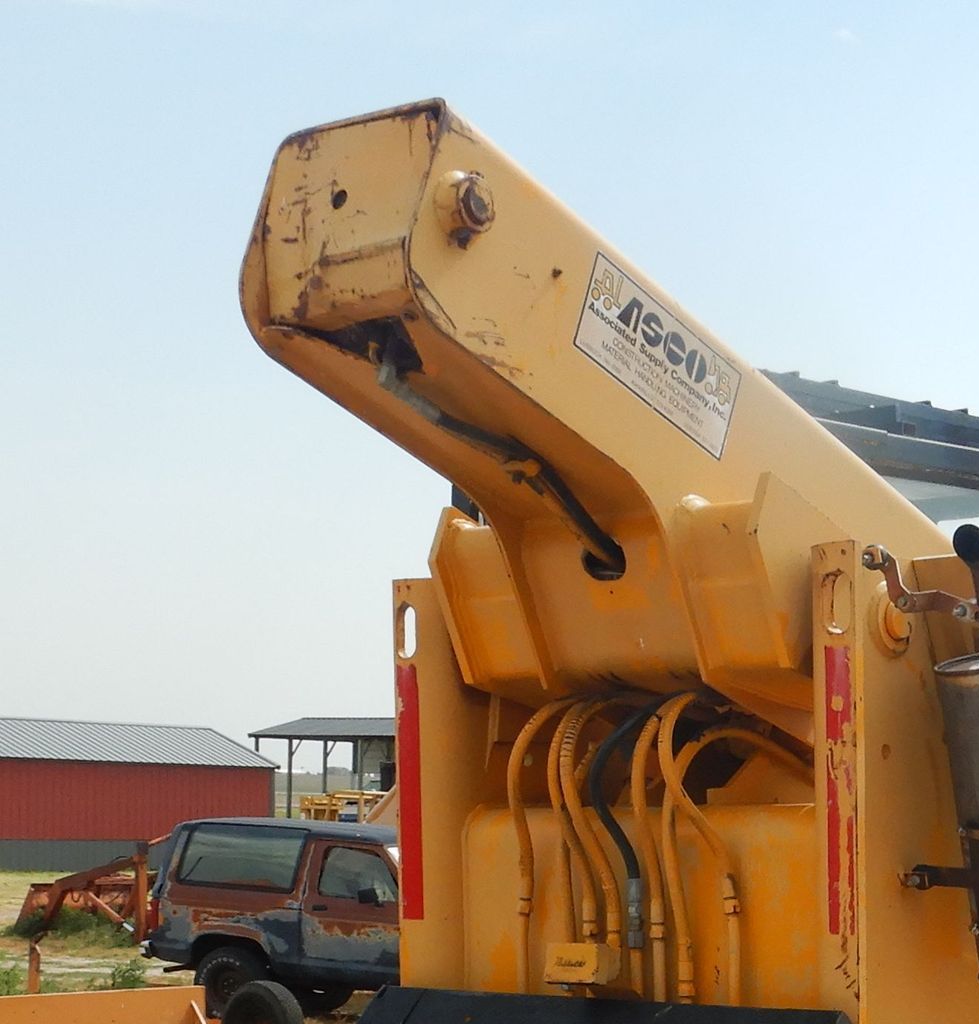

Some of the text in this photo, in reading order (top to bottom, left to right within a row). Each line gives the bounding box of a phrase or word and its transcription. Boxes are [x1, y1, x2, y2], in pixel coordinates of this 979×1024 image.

[588, 301, 637, 347] Associated
[639, 343, 669, 374] Supply
[616, 297, 707, 384] ASCO
